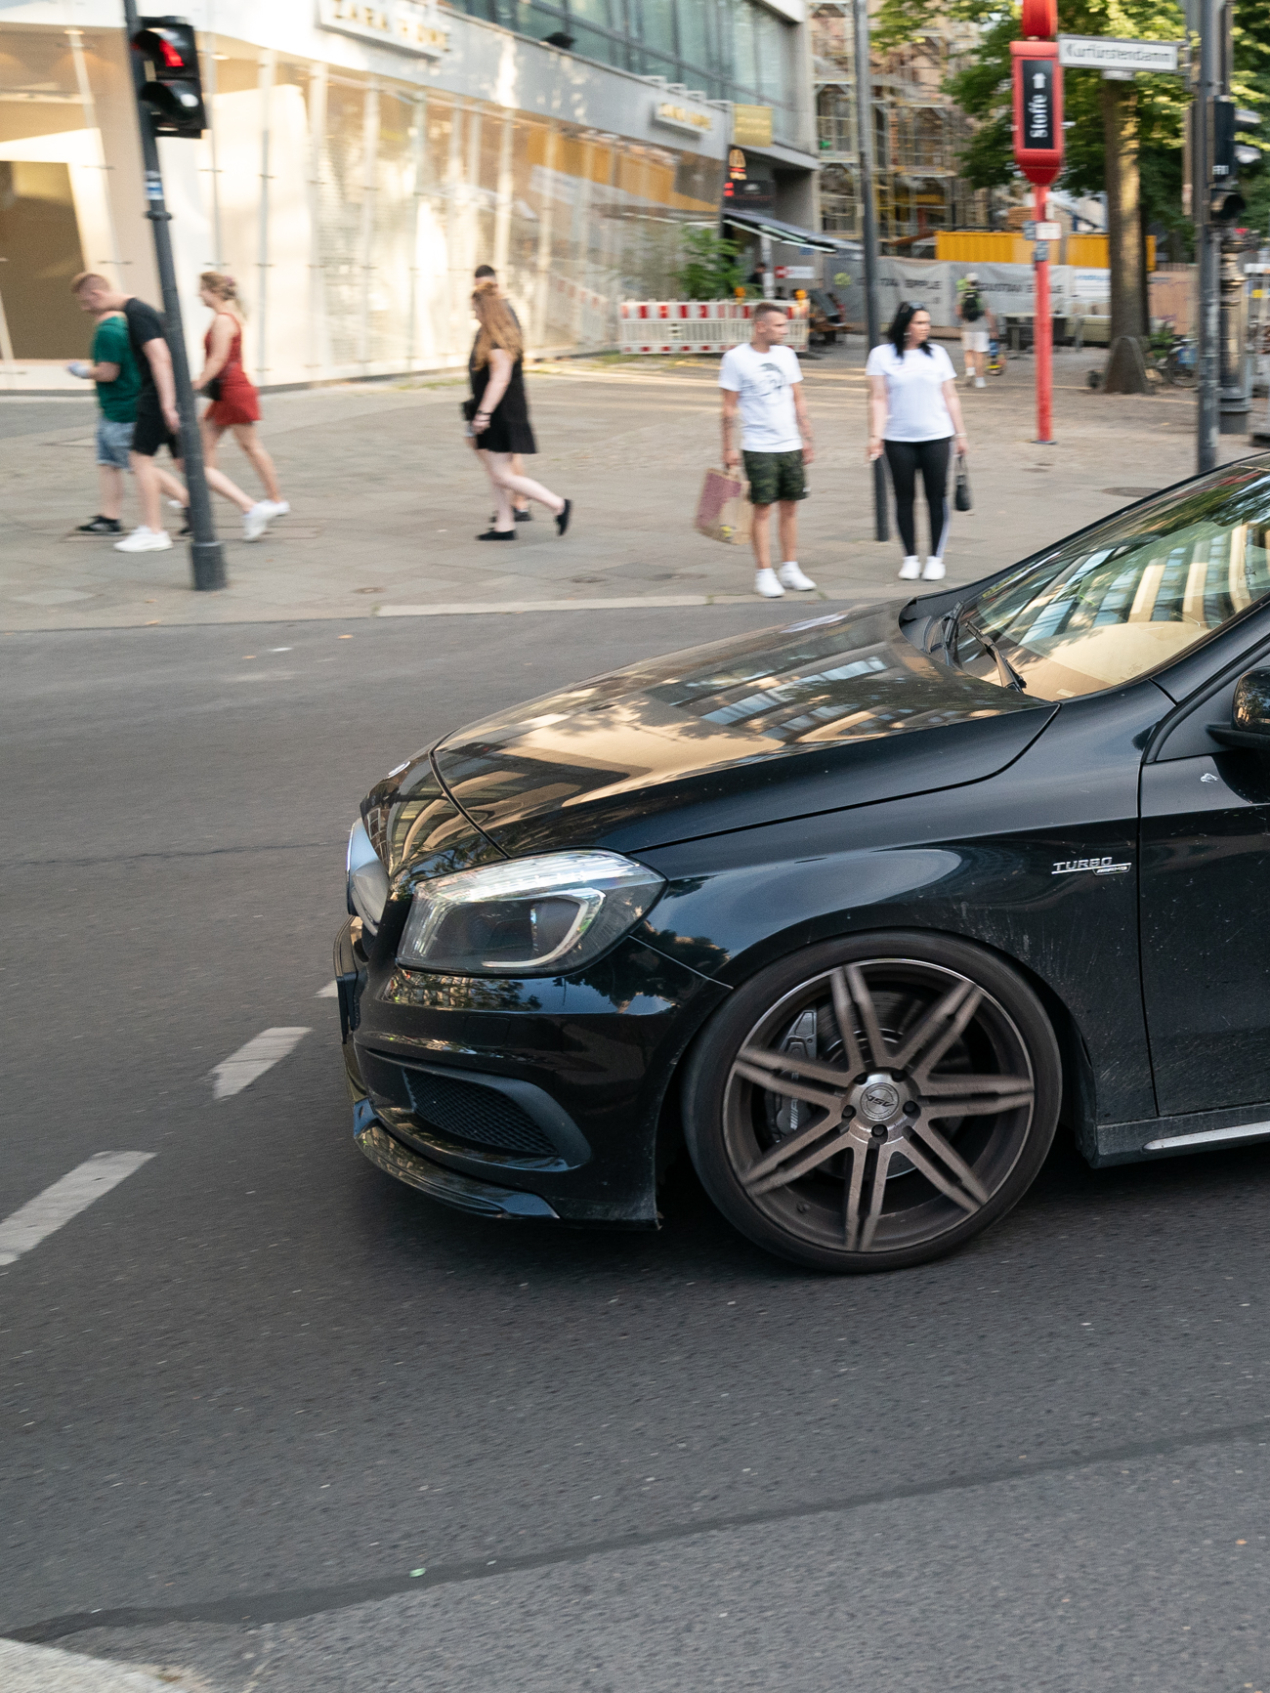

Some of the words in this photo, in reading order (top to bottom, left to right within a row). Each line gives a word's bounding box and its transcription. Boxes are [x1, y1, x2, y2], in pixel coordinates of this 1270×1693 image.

[1066, 43, 1171, 62] Kurfürstendamm
[1028, 94, 1048, 138] Stoffe
[1053, 857, 1112, 871] TURBO
